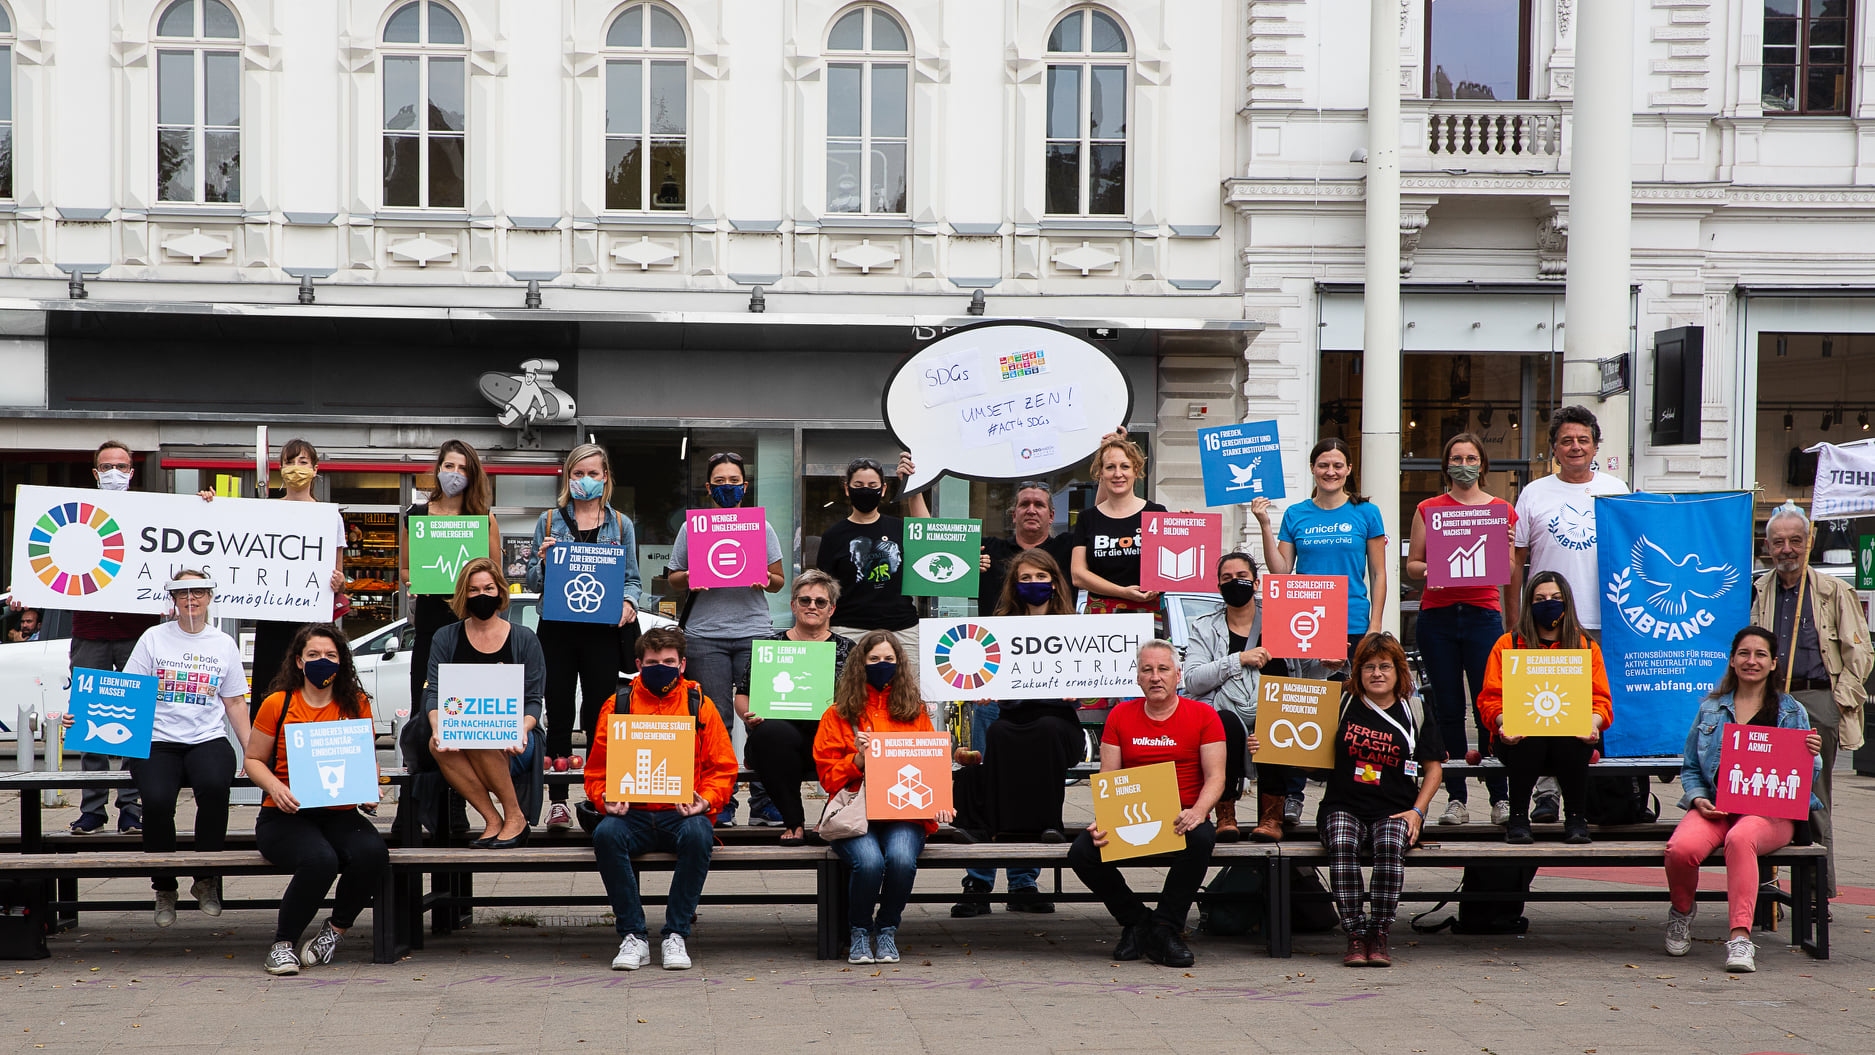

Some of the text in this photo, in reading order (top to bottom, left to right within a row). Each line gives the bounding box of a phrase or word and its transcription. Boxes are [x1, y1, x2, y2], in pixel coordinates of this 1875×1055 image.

[925, 364, 970, 387] SDGs
[1203, 432, 1221, 452] 16
[1221, 434, 1272, 448] GERECHTIGKEIT UND
[1222, 443, 1280, 457] STARKE INSTITUTIONEN
[711, 514, 738, 523] WENIGER
[1441, 508, 1491, 518] MENSCHENWÜRDIGE
[430, 521, 480, 530] GESUNDHEIT UND
[690, 515, 709, 534] 10
[1148, 517, 1158, 535] 4
[1163, 517, 1206, 527] HOCHWERTIGE
[1432, 512, 1441, 530] 8
[1442, 519, 1460, 527] ARBEIT
[1460, 519, 1471, 527] UND
[415, 521, 425, 539] 3
[430, 530, 474, 538] WOHLERGEHEN
[711, 523, 760, 533] UNGLEICHHEITEN
[908, 523, 923, 541] 13
[926, 523, 981, 534] MASSNAHMEN ZUM
[1163, 526, 1189, 536] BILDUNG
[1304, 522, 1339, 534] unicef
[1442, 528, 1472, 537] WACHSTUM
[926, 532, 967, 542] KLIMASCHUTZ
[1303, 538, 1313, 546] for
[1335, 536, 1353, 544] child
[1555, 534, 1597, 551] ABFANG
[139, 526, 323, 562] SDGWATCH
[552, 546, 567, 565] 17
[570, 545, 625, 557] PARTNERSCHAFTEN
[653, 552, 670, 560] iPad
[1094, 549, 1107, 557] für
[569, 554, 617, 565] ZUR ERREICHUNG
[569, 564, 597, 573] DER ZIELE
[137, 562, 320, 589] AUSTRIA
[1269, 580, 1280, 599] 5
[1286, 581, 1337, 590] GESCHLECHTER-
[213, 590, 320, 608] ermöglichen!
[1286, 590, 1322, 600] GLEICHHEIT
[1623, 606, 1716, 642] ABFANG
[777, 646, 806, 655] LEBEN AN
[1010, 634, 1138, 655] SDGWATCH
[183, 653, 218, 664] Globale
[757, 646, 774, 664] 15
[777, 655, 794, 664] LAND
[1526, 656, 1583, 665] BEZAHLBARE UND
[1624, 649, 1729, 661] AKTIONSBÜNDNIS FÜR FRIEDEN,
[156, 657, 222, 673] Verantwortung
[1010, 658, 1138, 674] AUSTRIA
[1510, 656, 1519, 675] 7
[1624, 659, 1713, 669] AKTIVE NEUTRALITÄT UND
[1526, 666, 1584, 675] SAUBERE ENERGIE
[1625, 667, 1687, 677] GEWALTFREIHEIT
[78, 674, 94, 693] 14
[99, 676, 141, 689] LEBEN UNTER
[1011, 675, 1139, 689] Zukunft ermöglichen
[1626, 680, 1714, 693] www.abfang.org
[99, 686, 126, 697] WASSER
[1264, 682, 1280, 702] 12
[1283, 683, 1327, 695] NACHHALTIGE/R
[1282, 694, 1318, 705] KONSUM UND
[464, 698, 517, 715] ZIELE
[1281, 704, 1317, 715] PRODUKTION
[443, 718, 518, 728] FÜR NACHHALTIGE
[631, 721, 692, 731] NACHHALTIGE STÄDTE
[310, 725, 370, 737] SAUBERES WASSER
[443, 730, 518, 741] ENTWICKLUNG
[613, 721, 627, 740] 11
[631, 732, 676, 741] UND GEMEINDEN
[1346, 721, 1393, 741] VEREIN
[294, 730, 304, 748] 6
[311, 737, 354, 747] UND SANITÄR-
[885, 738, 949, 747] INDUSTRIE, INNOVATION
[1343, 731, 1400, 755] PLASTIC
[1733, 730, 1740, 750] 1
[1749, 732, 1769, 742] KEINE
[311, 746, 361, 757] EINRICHTUNGEN
[871, 739, 882, 758] 9
[885, 749, 943, 757] UND INFRASTRUKTUR
[1747, 742, 1773, 753] ARMUT
[1348, 746, 1400, 767] PLANET
[1114, 775, 1129, 785] KEIN
[1099, 779, 1110, 799] 2
[1115, 784, 1141, 796] HUNGER
